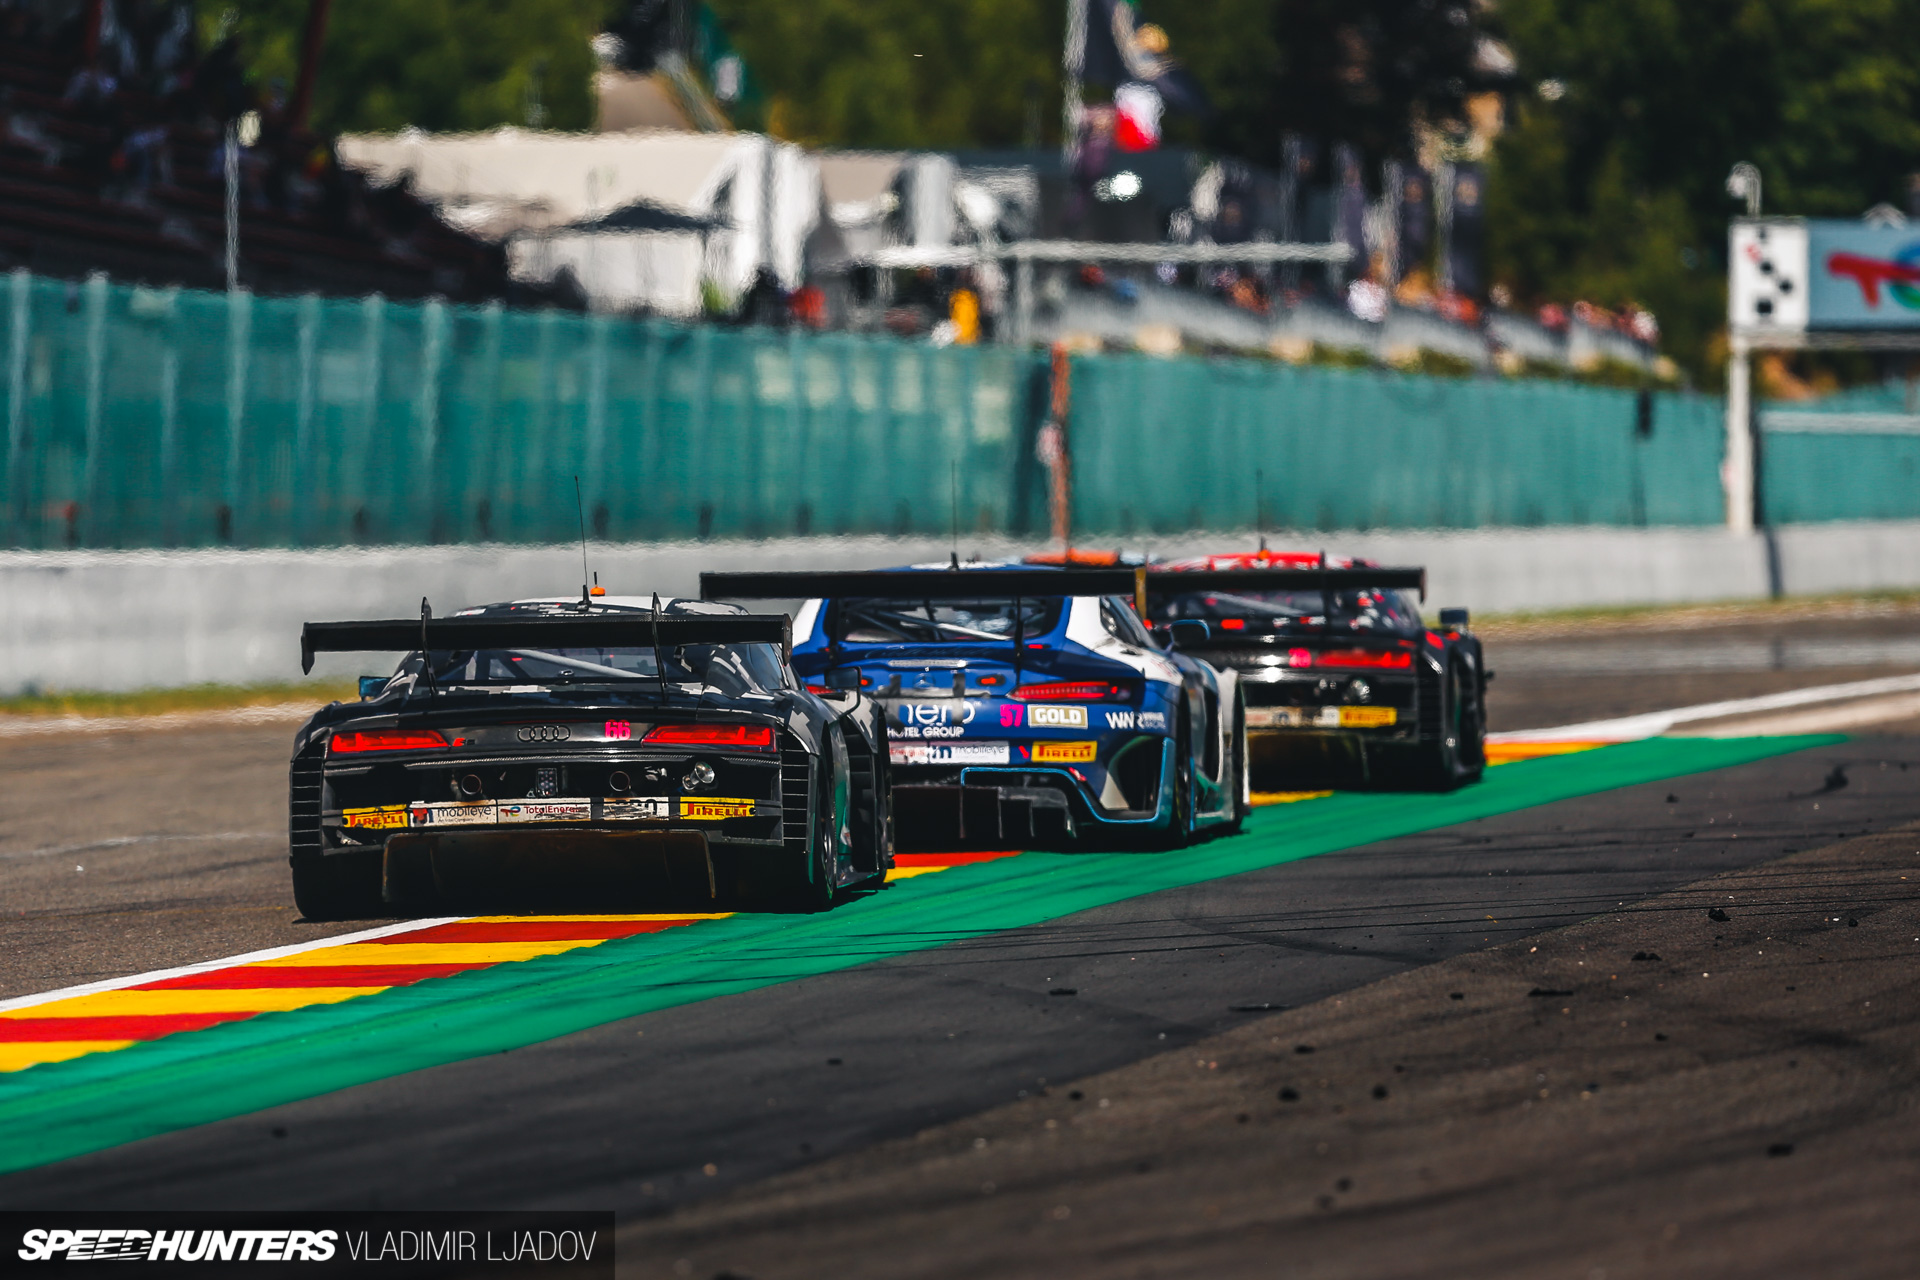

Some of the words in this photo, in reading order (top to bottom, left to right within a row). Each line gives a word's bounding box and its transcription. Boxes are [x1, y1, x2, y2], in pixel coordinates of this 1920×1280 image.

[1000, 704, 1025, 728] 57
[1034, 707, 1082, 725] GOLD
[604, 719, 632, 741] 66
[922, 726, 965, 739] GROUP
[1038, 745, 1092, 758] PIRELLI
[437, 805, 492, 818] mobileye
[523, 804, 589, 815] TotalEneri
[687, 803, 748, 817] PIRELLI
[350, 811, 404, 828] PIRELLI
